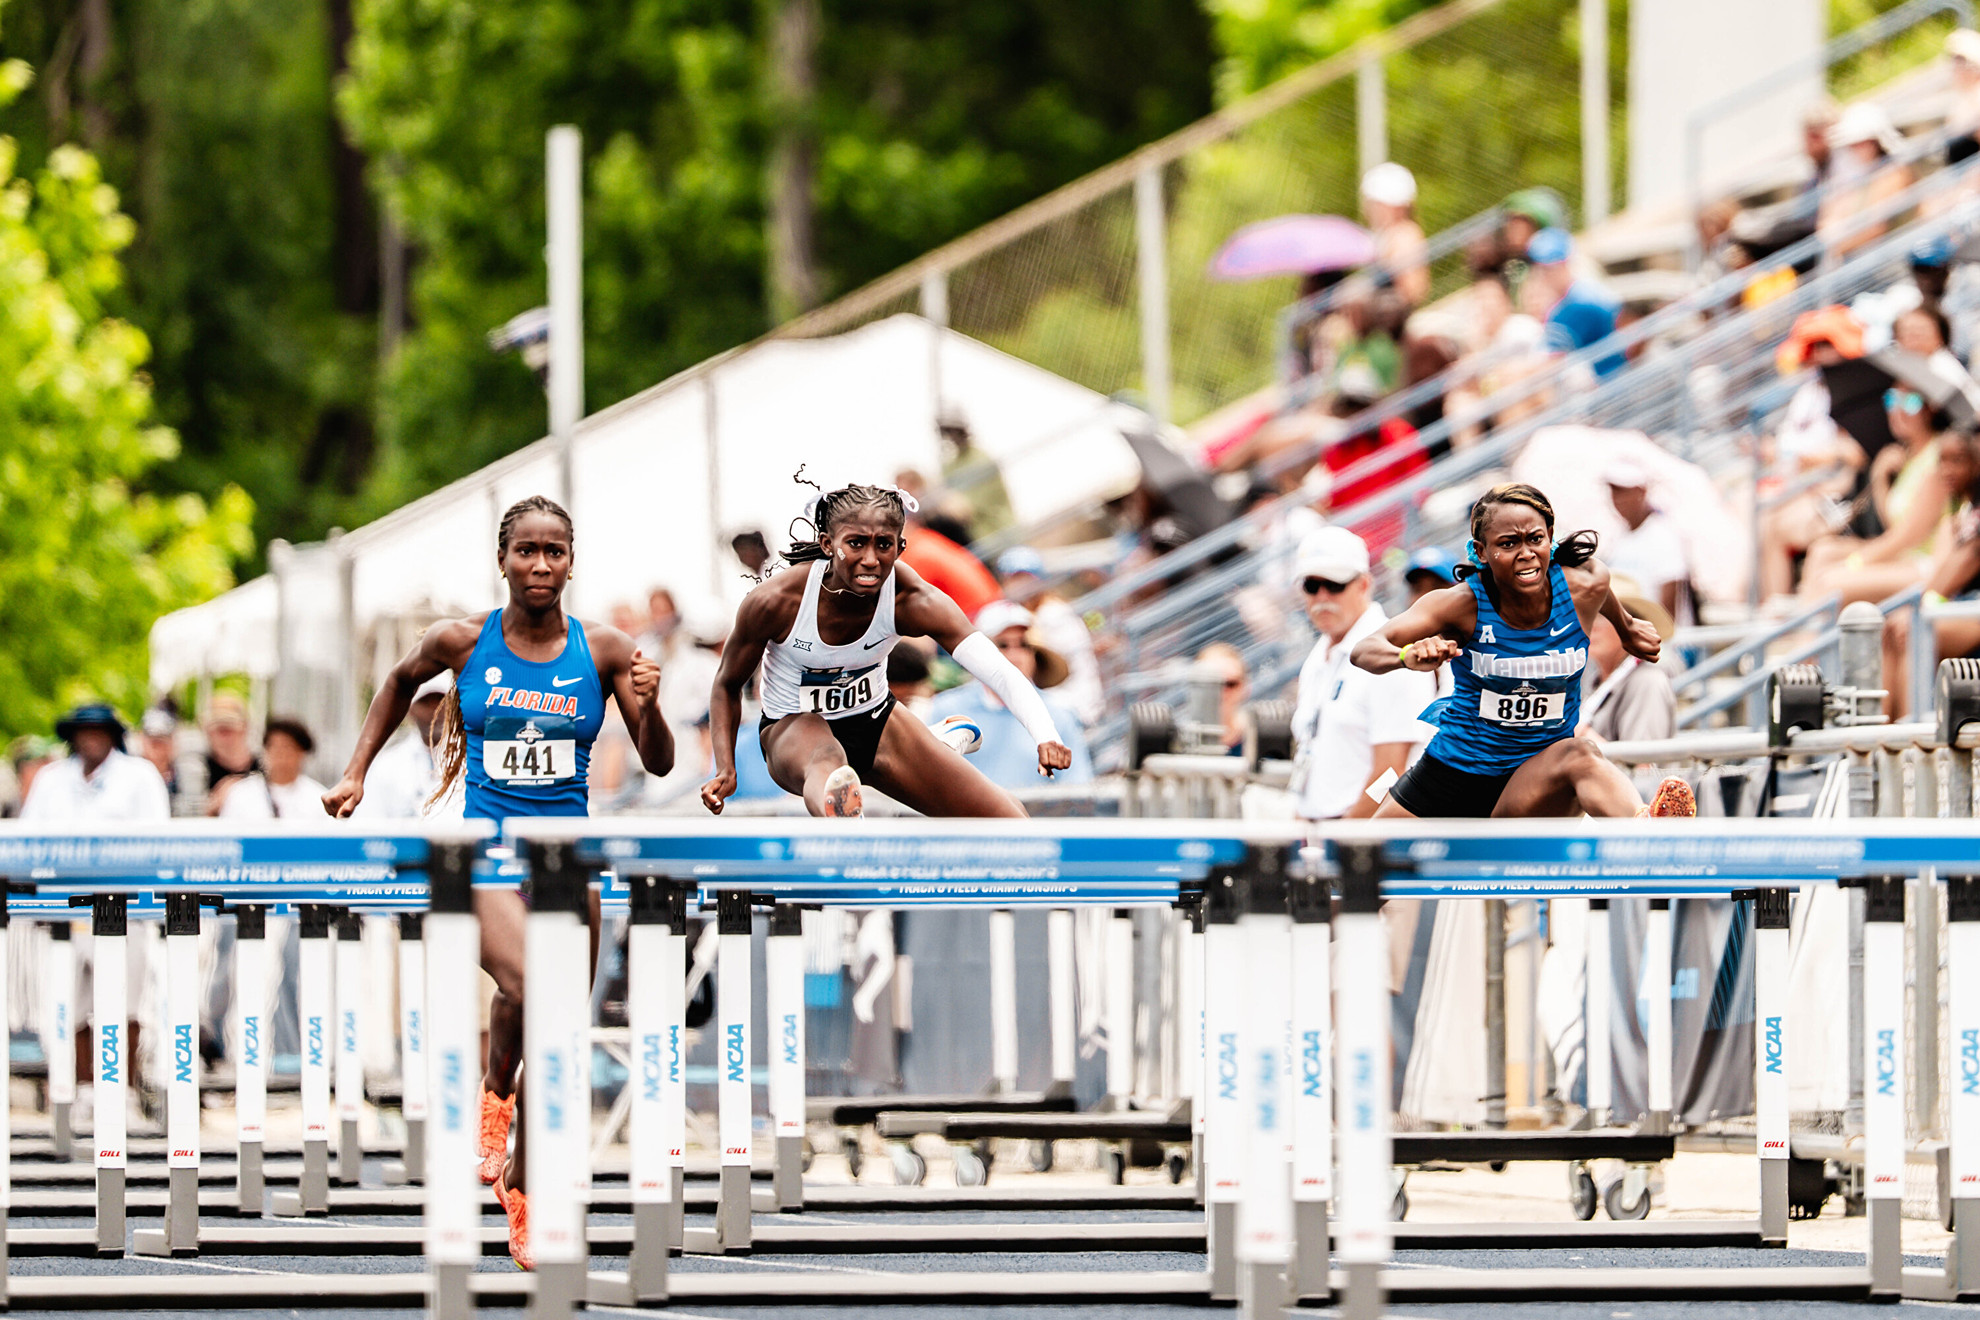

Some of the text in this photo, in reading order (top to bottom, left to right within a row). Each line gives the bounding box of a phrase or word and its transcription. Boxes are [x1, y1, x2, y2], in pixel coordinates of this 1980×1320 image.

[1468, 646, 1587, 679] Memphis
[485, 686, 578, 716] FLORIDA
[809, 677, 872, 713] 1609
[1498, 697, 1549, 720] 896
[502, 745, 556, 775] 441
[102, 1024, 119, 1083] NCAA
[175, 1024, 192, 1083] NCAA
[245, 1016, 258, 1067] NCAA
[309, 1016, 323, 1067] NCAA
[727, 1024, 744, 1083] NCAA
[783, 1014, 797, 1064] NCAA
[1303, 1030, 1321, 1097] NCAA
[1766, 1016, 1782, 1074] NCAA
[1877, 1029, 1895, 1096] NCAA
[1961, 1028, 1980, 1096] NCAA
[643, 1033, 662, 1101] NCAA
[1219, 1033, 1237, 1100] NCAA
[1874, 1174, 1898, 1182] GILL
